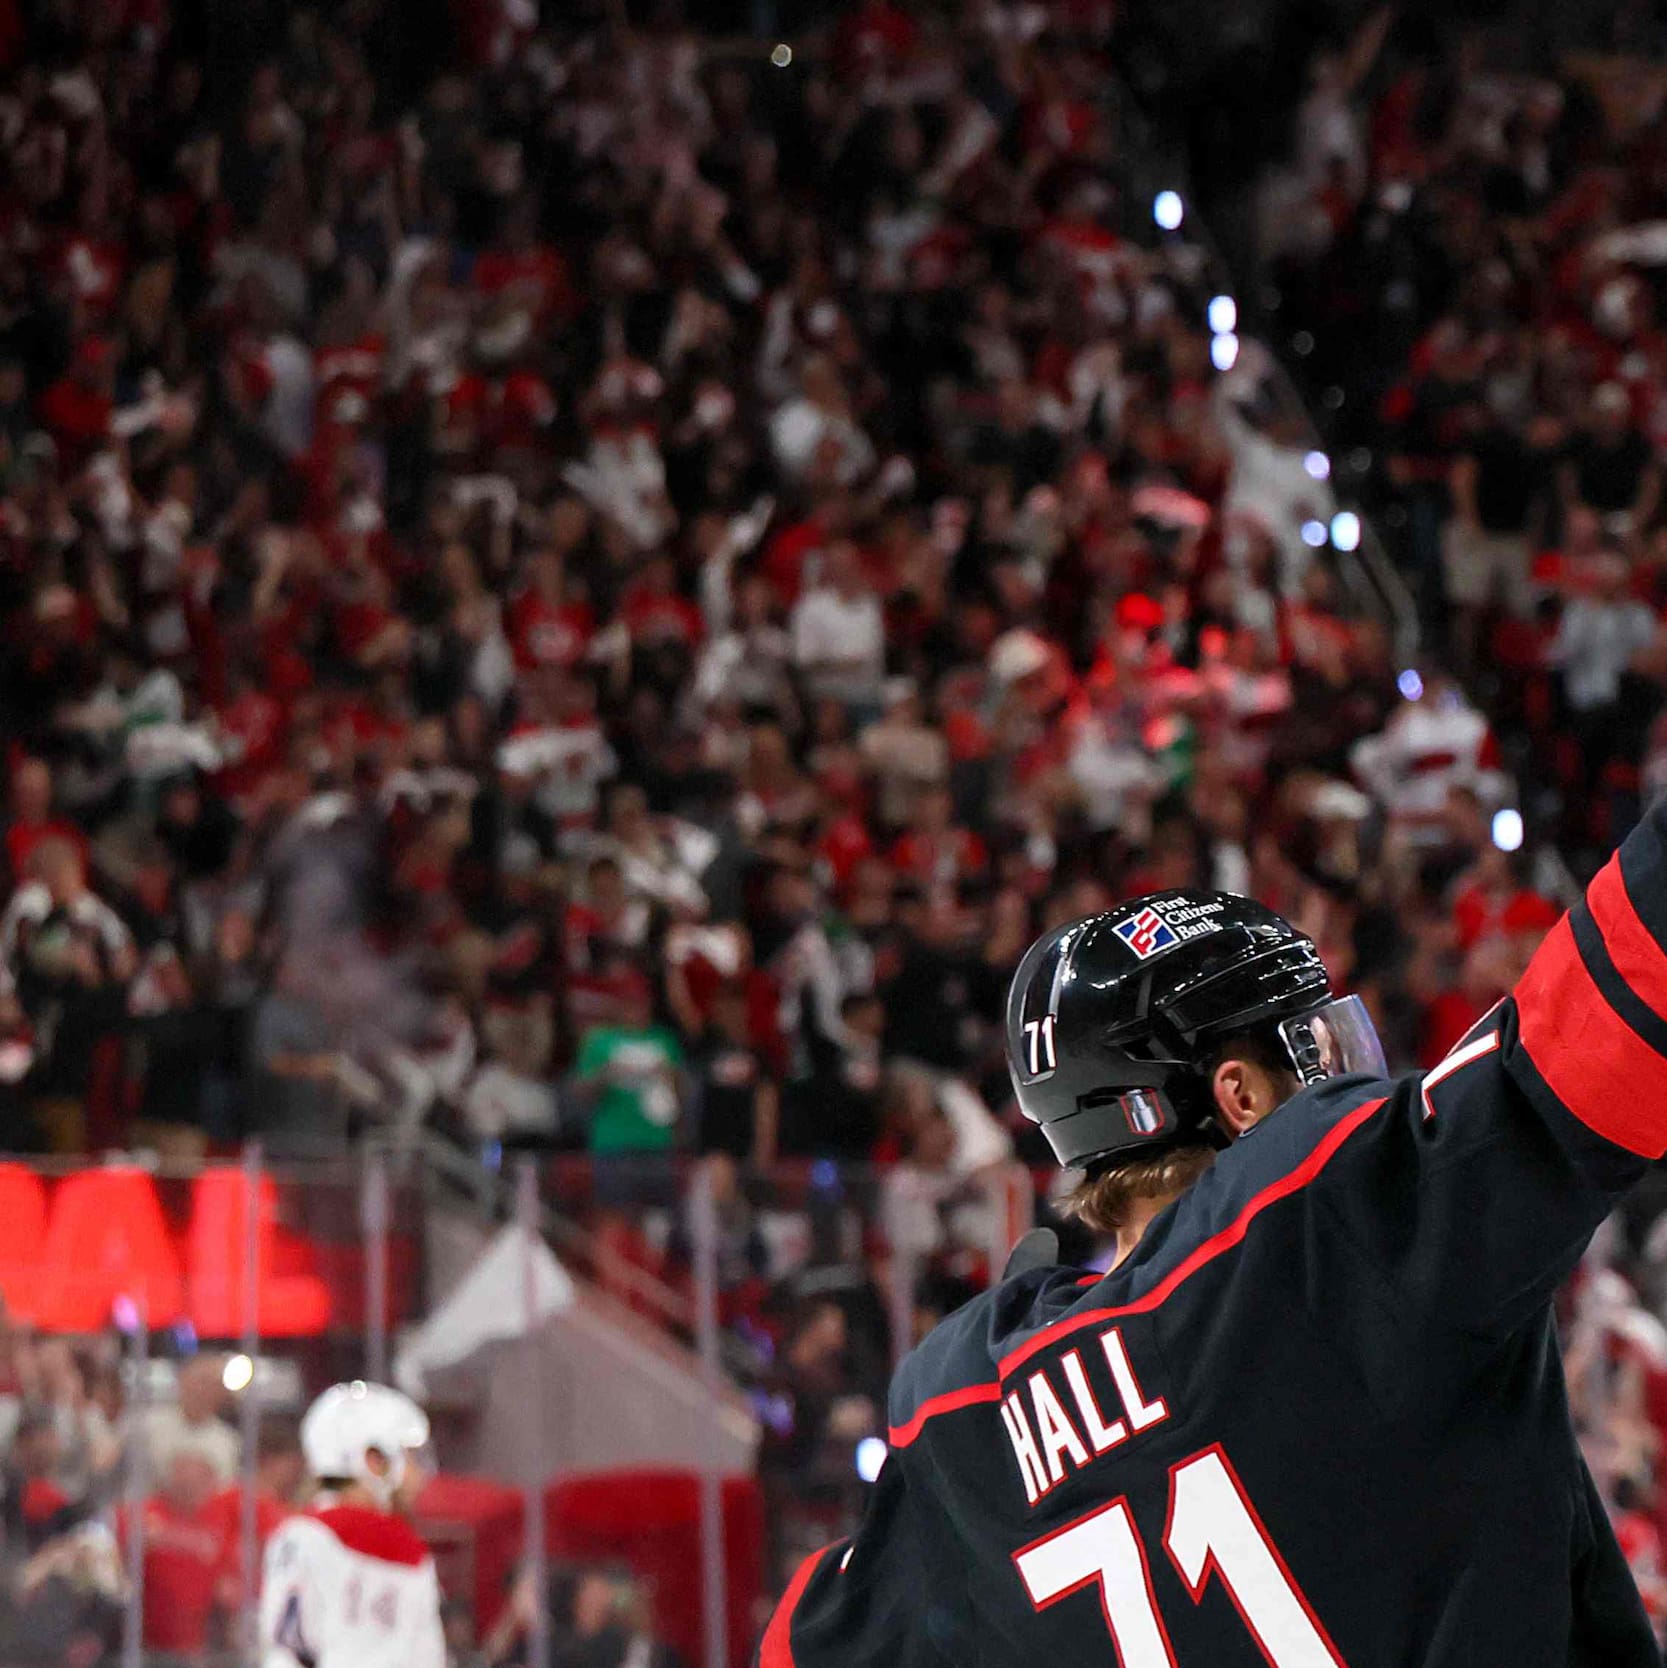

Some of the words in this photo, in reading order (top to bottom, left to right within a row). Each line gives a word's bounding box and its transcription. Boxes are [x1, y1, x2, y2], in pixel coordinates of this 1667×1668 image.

[1151, 896, 1190, 914] First
[1164, 902, 1224, 925] Citizens
[1175, 917, 1221, 940] Bank
[1023, 1014, 1056, 1074] 71
[1000, 1327, 1170, 1506] HALL
